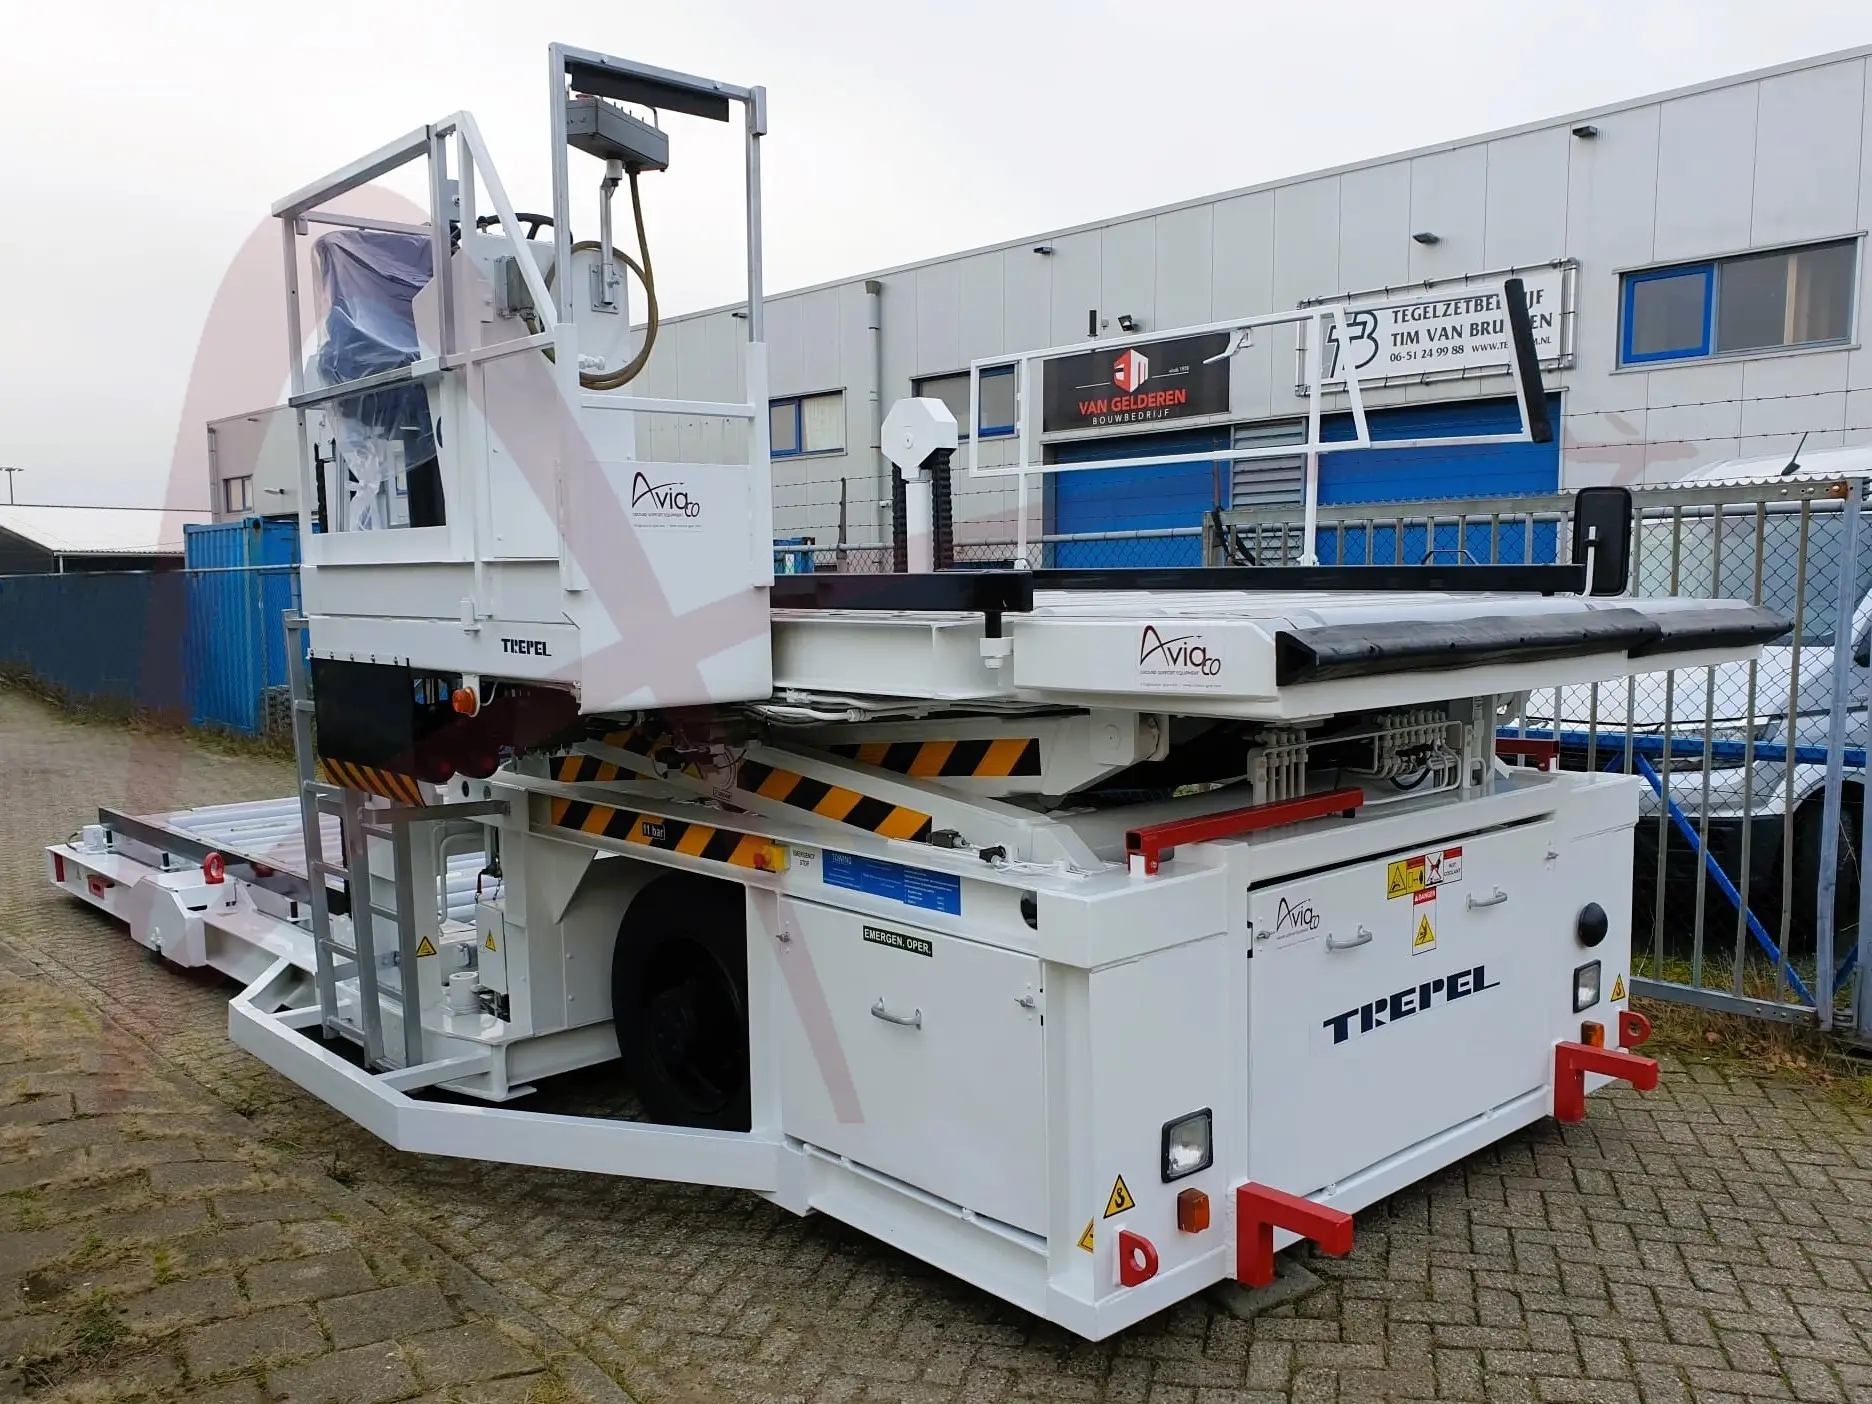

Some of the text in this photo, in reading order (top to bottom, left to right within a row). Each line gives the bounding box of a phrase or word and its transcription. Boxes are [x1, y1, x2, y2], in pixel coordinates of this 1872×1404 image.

[1392, 288, 1545, 324] TEGELZETBEJF
[1391, 312, 1553, 347] TIM VAN BRUEN
[1389, 350, 1418, 362] 06-51
[1420, 348, 1433, 360] 24
[1436, 346, 1449, 358] 99
[1451, 344, 1465, 356] 88
[1078, 389, 1187, 416] VAN GELDEREN
[1092, 408, 1171, 425] BOUWBEDRIJF
[501, 638, 552, 657] TREPEL
[906, 939, 931, 955] OPER.
[1323, 965, 1501, 1045] TREPEL
